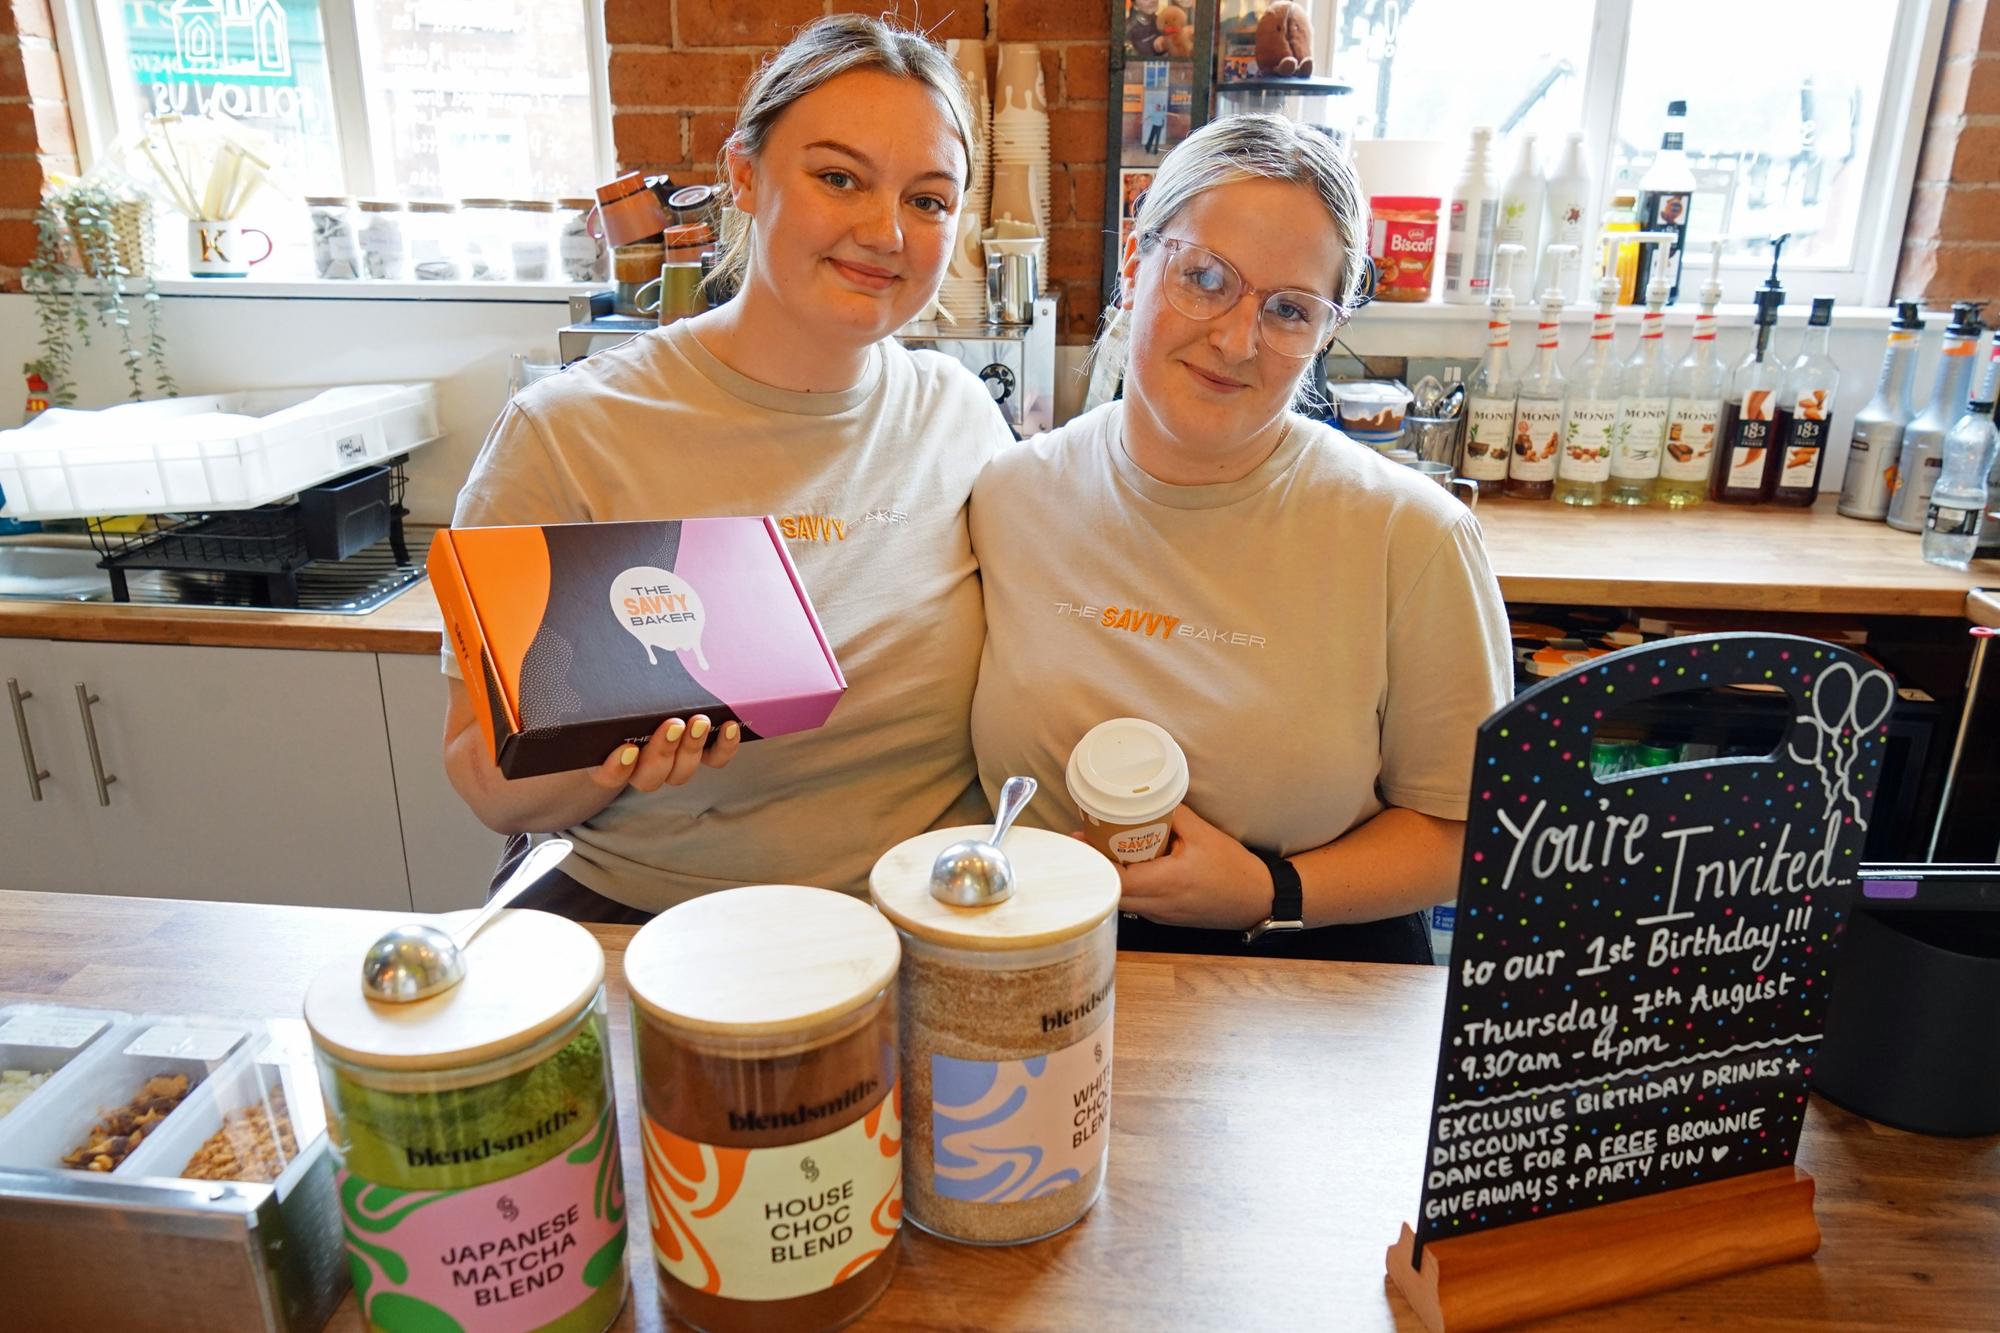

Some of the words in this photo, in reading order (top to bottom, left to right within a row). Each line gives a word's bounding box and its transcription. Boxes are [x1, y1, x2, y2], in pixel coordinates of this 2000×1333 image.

[1391, 234, 1434, 252] Biscoff
[781, 514, 846, 541] SAVVY
[624, 593, 689, 616] SAVVY
[631, 585, 671, 596] THE
[631, 612, 696, 626] BAKER
[1054, 602, 1099, 619] THE
[1101, 606, 1180, 639] SAVVY
[1177, 624, 1267, 649] BAKER
[1117, 832, 1161, 849] SAVVY
[1117, 839, 1161, 853] BAKER
[1497, 798, 1650, 890] You're
[1462, 959, 1497, 987] to
[1504, 950, 1565, 981] our
[1576, 935, 1636, 976] 1st
[1647, 906, 1812, 972] Birthday!!!
[1632, 985, 1682, 1023] 7th
[1690, 972, 1796, 1014] August
[1461, 1050, 1562, 1082] 9.30am
[1591, 1034, 1669, 1066] 4pm
[1438, 1099, 1566, 1141] EXCLUSIVE
[1576, 1072, 1695, 1115] BIRTHDAY
[1701, 1057, 1783, 1089] DRINKS
[405, 1107, 579, 1168] blendsmiths
[1428, 1157, 1513, 1190] DANCE
[1524, 1148, 1566, 1173] FOR
[1574, 1143, 1592, 1165] A
[1600, 1129, 1658, 1161] FREE
[1666, 1107, 1766, 1146] BROWNIE
[1433, 1124, 1569, 1167] DISCOUNTS
[764, 1180, 854, 1221] HOUSE
[1425, 1175, 1558, 1220] GIVEAWAYS
[1584, 1156, 1653, 1189] PARTY
[1660, 1146, 1705, 1171] FUN
[440, 1203, 580, 1266] JAPANESE
[770, 1205, 851, 1242] CHOC
[771, 1226, 853, 1264] BLEND
[451, 1232, 578, 1287] MATCHA
[474, 1263, 565, 1307] BLEND
